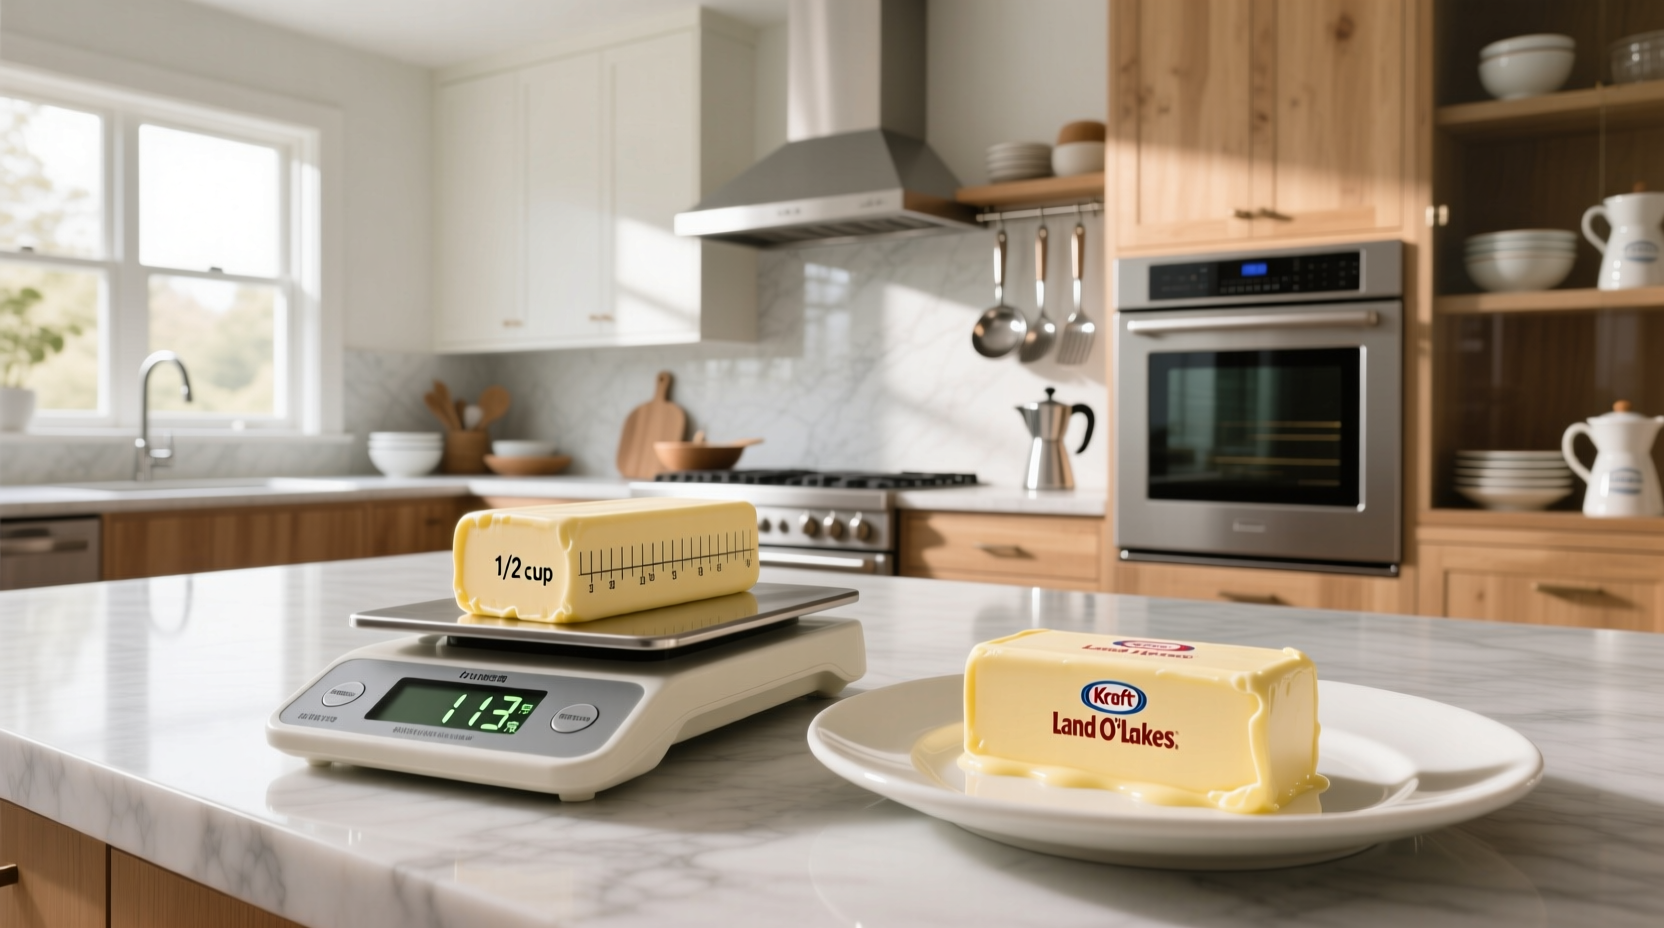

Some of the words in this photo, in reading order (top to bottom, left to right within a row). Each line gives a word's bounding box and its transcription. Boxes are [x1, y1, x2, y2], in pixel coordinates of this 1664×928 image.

[495, 554, 521, 580] 1/2
[525, 566, 553, 586] cup
[1093, 686, 1135, 707] Kraft
[441, 694, 523, 731] 113
[1052, 711, 1096, 738] Land
